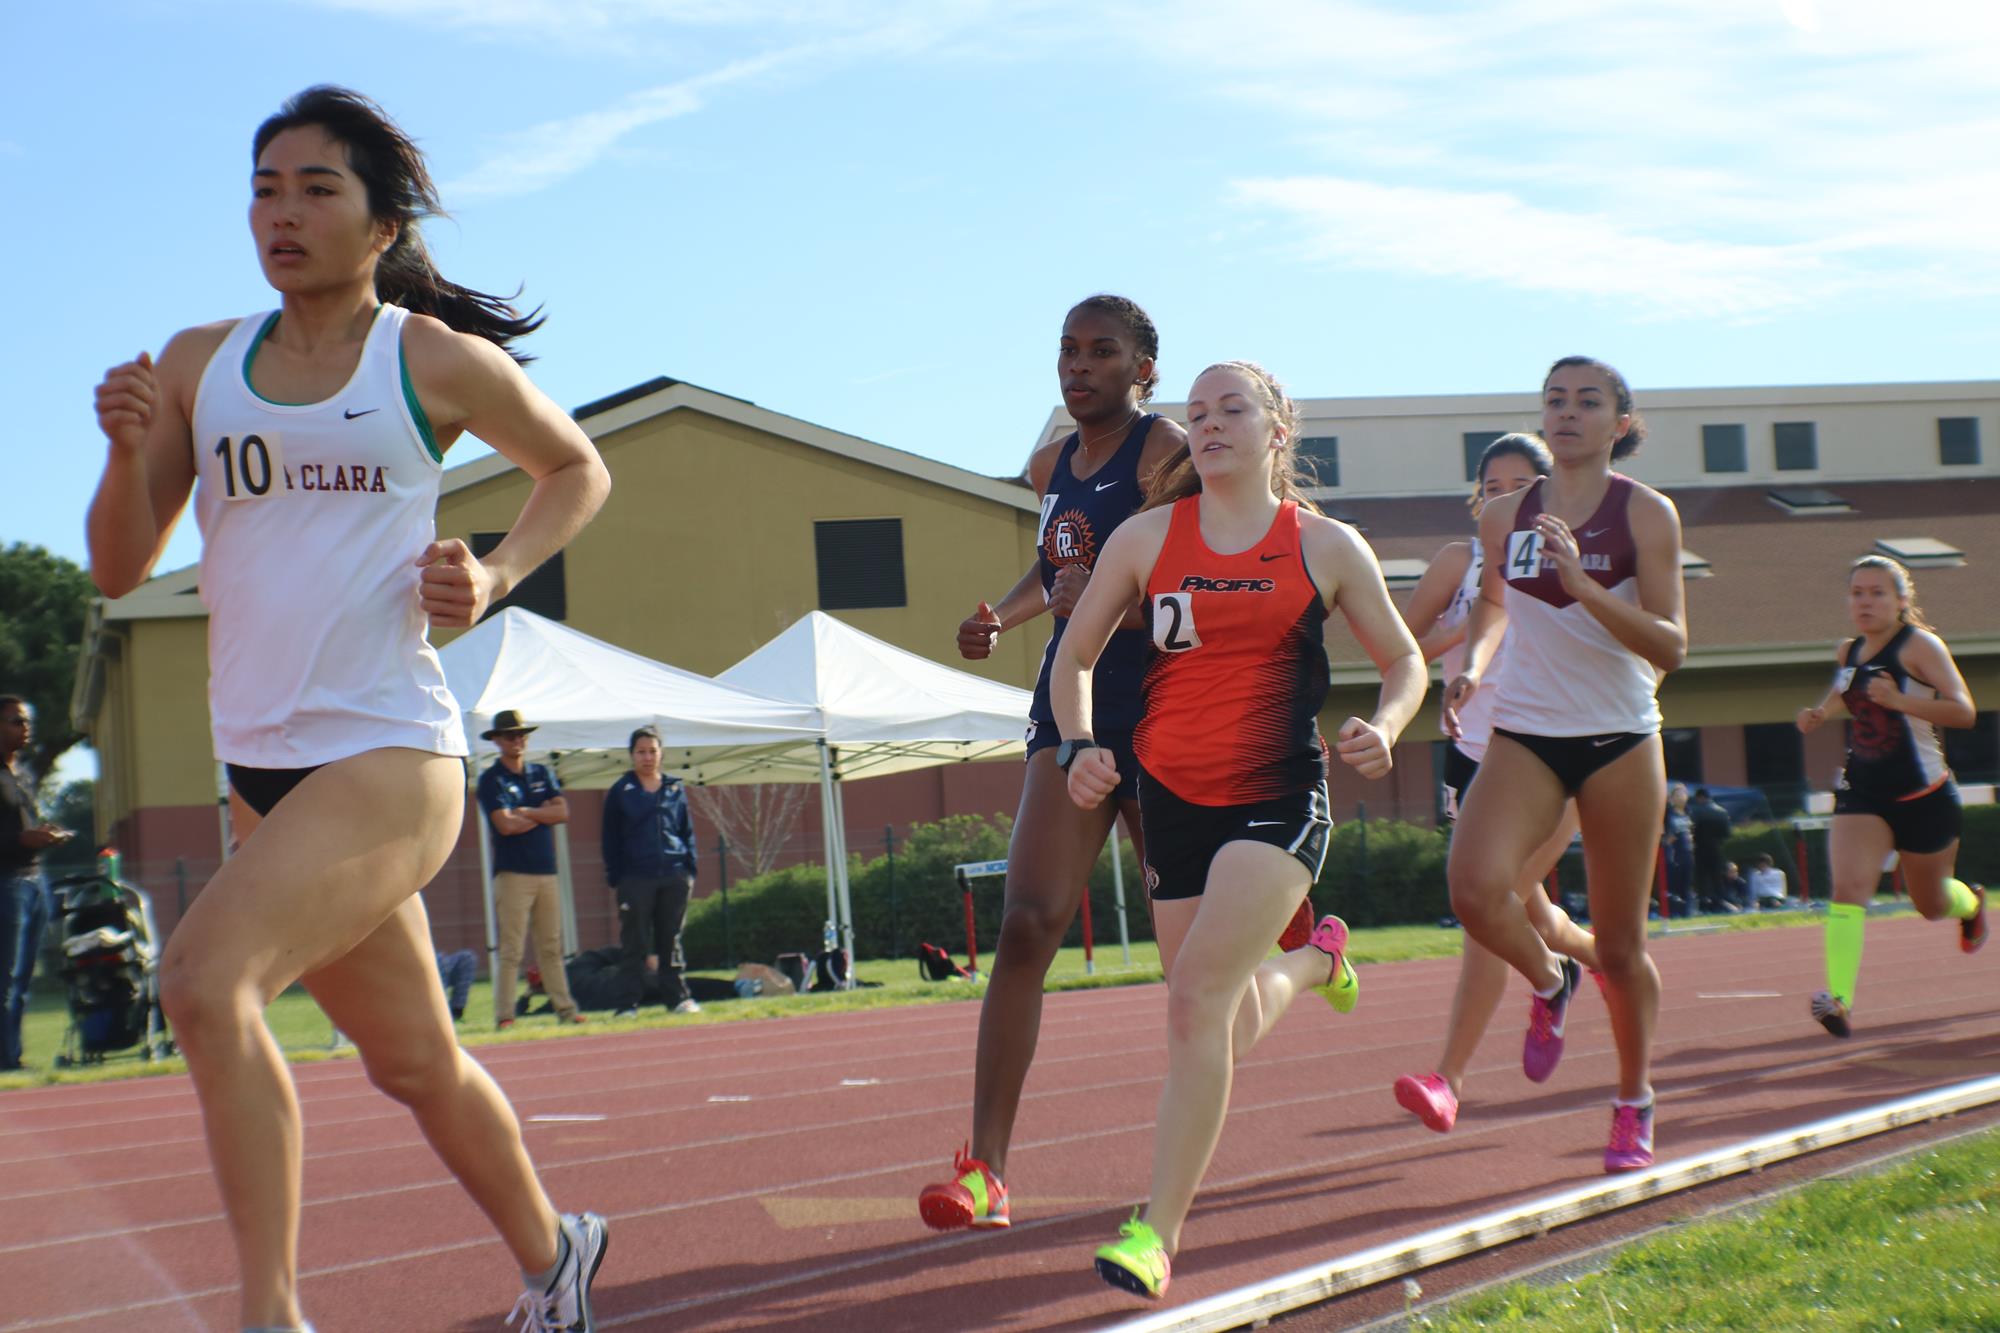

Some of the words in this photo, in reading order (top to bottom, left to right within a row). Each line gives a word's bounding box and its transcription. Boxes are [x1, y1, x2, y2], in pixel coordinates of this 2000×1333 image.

[214, 434, 271, 497] 10
[301, 464, 387, 492] CLARA
[1514, 533, 1537, 575] 4
[1179, 575, 1275, 593] PACIFIC
[1160, 596, 1192, 650] 2
